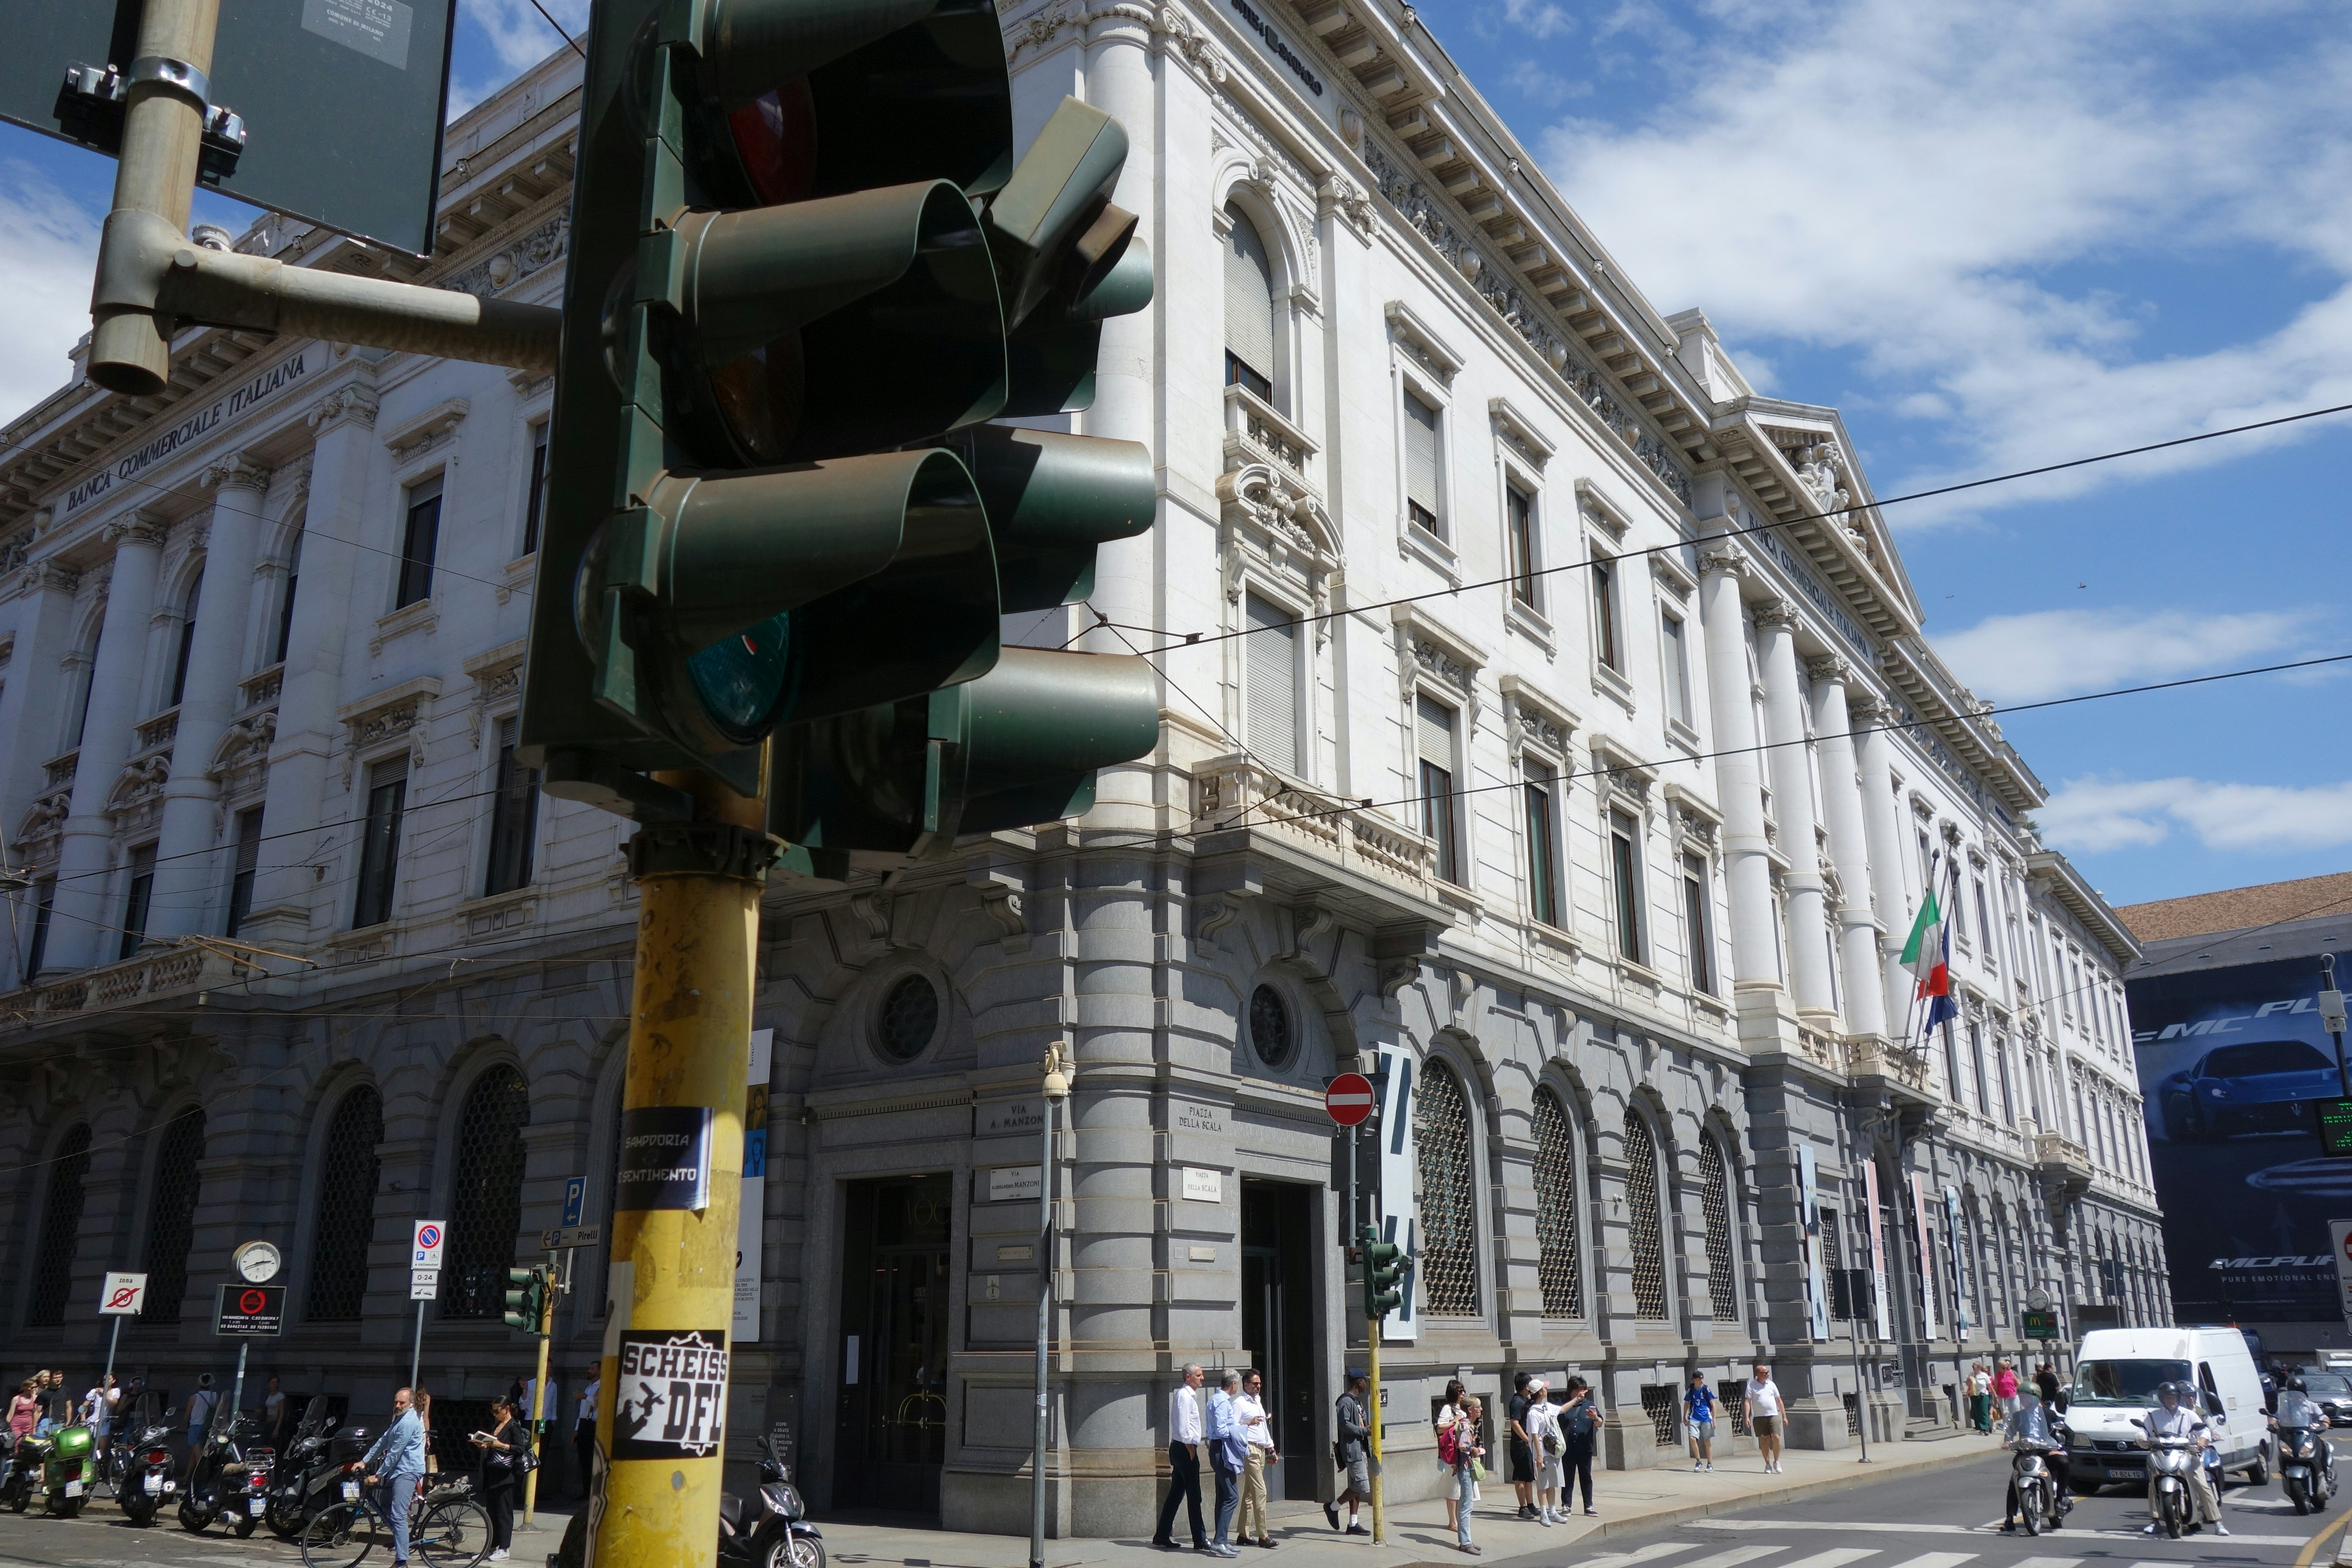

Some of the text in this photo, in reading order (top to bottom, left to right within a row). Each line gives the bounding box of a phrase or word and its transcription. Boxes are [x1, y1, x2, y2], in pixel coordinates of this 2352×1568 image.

[327, 9, 352, 24] COMUNE
[361, 23, 384, 37] MILANO
[67, 355, 304, 512] BANCA COMMERCIALE ITALIANA
[1749, 511, 1868, 658] BANCA COMMERCIALE ITALIANA
[1011, 1105, 1026, 1114] VIA
[1004, 1115, 1044, 1128] MANZON
[1179, 1117, 1222, 1132] DELLA SCALA
[625, 1134, 690, 1148] SAMPDORIA
[622, 1168, 697, 1182] SENTIMENTO
[567, 1184, 580, 1207] P
[1202, 1185, 1217, 1193] SCALA
[578, 1230, 597, 1240] Pirelli
[623, 1345, 727, 1381] SCHEISS
[663, 1381, 722, 1442] DFL
